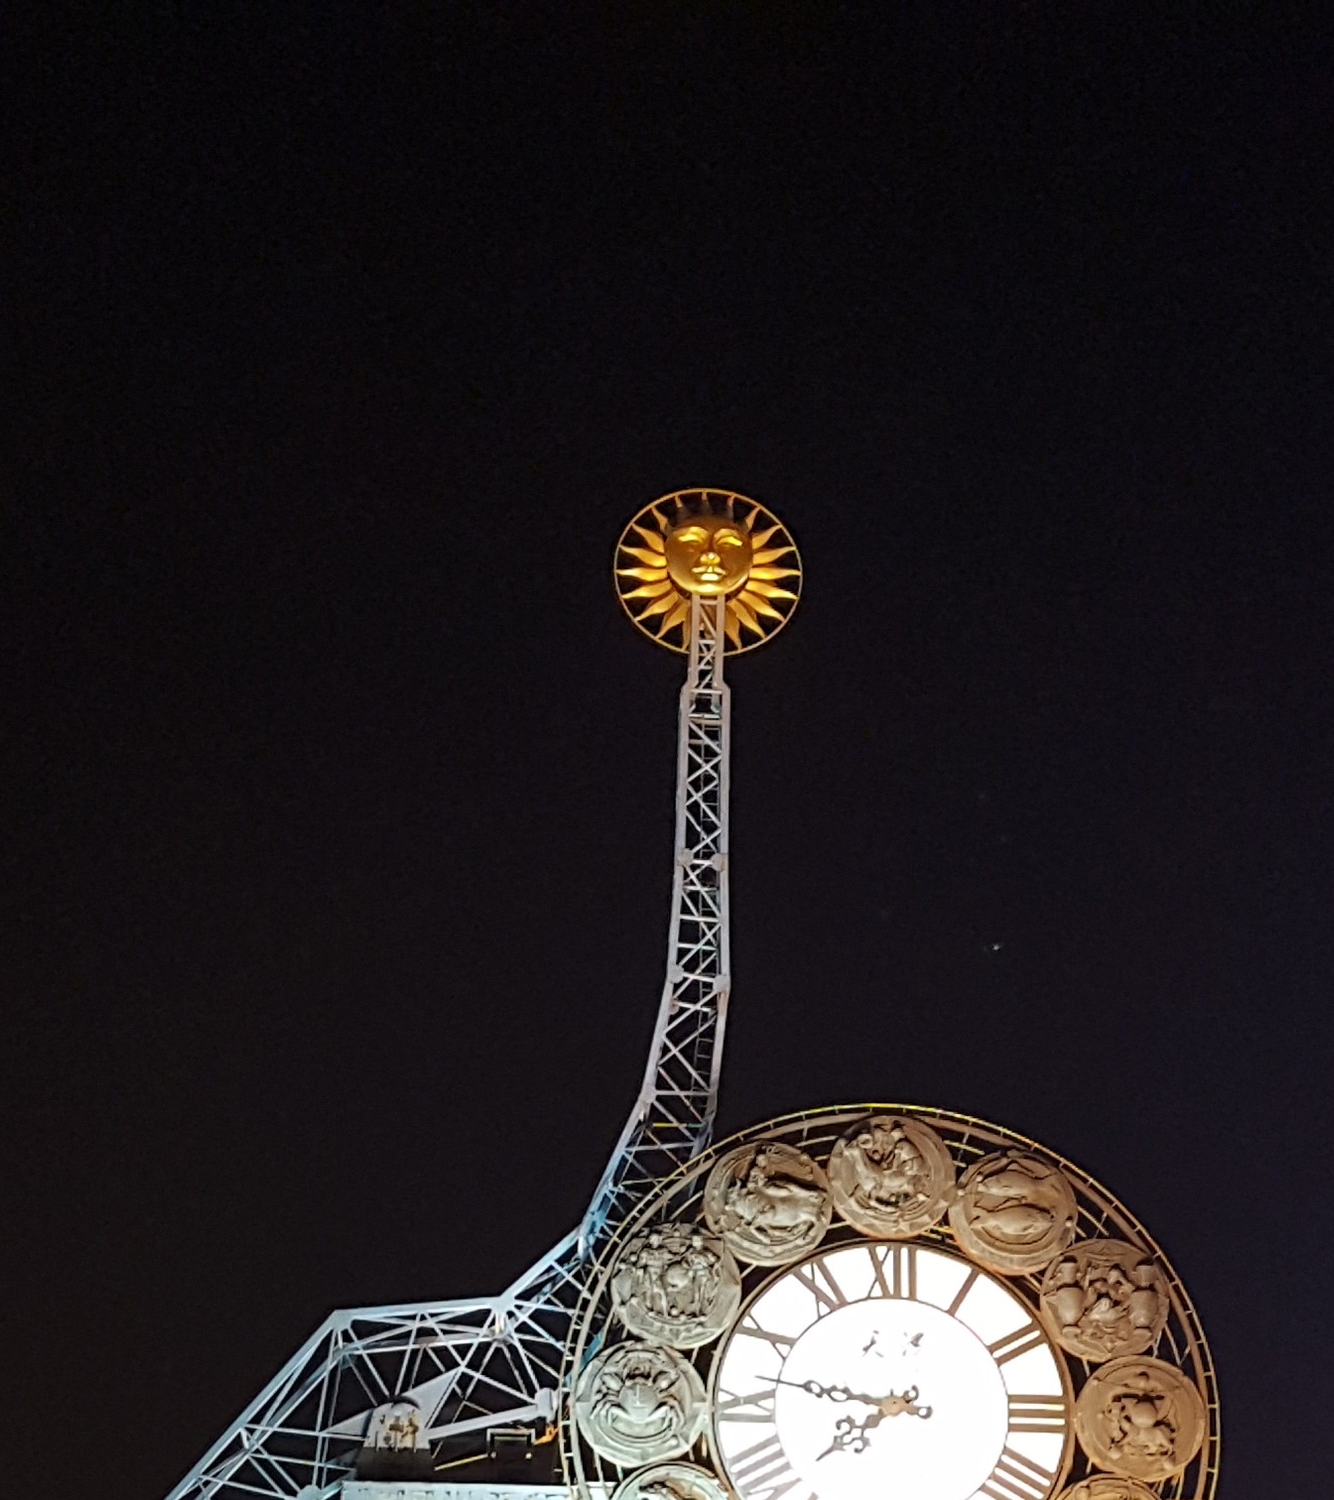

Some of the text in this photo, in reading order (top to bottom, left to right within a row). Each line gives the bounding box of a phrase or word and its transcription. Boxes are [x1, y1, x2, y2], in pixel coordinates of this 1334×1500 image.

[792, 1258, 849, 1320] XI
[867, 1246, 917, 1299] XII
[734, 1313, 798, 1361] X
[986, 1321, 1049, 1368] II
[718, 1387, 777, 1424] IX
[1007, 1394, 1066, 1433] III
